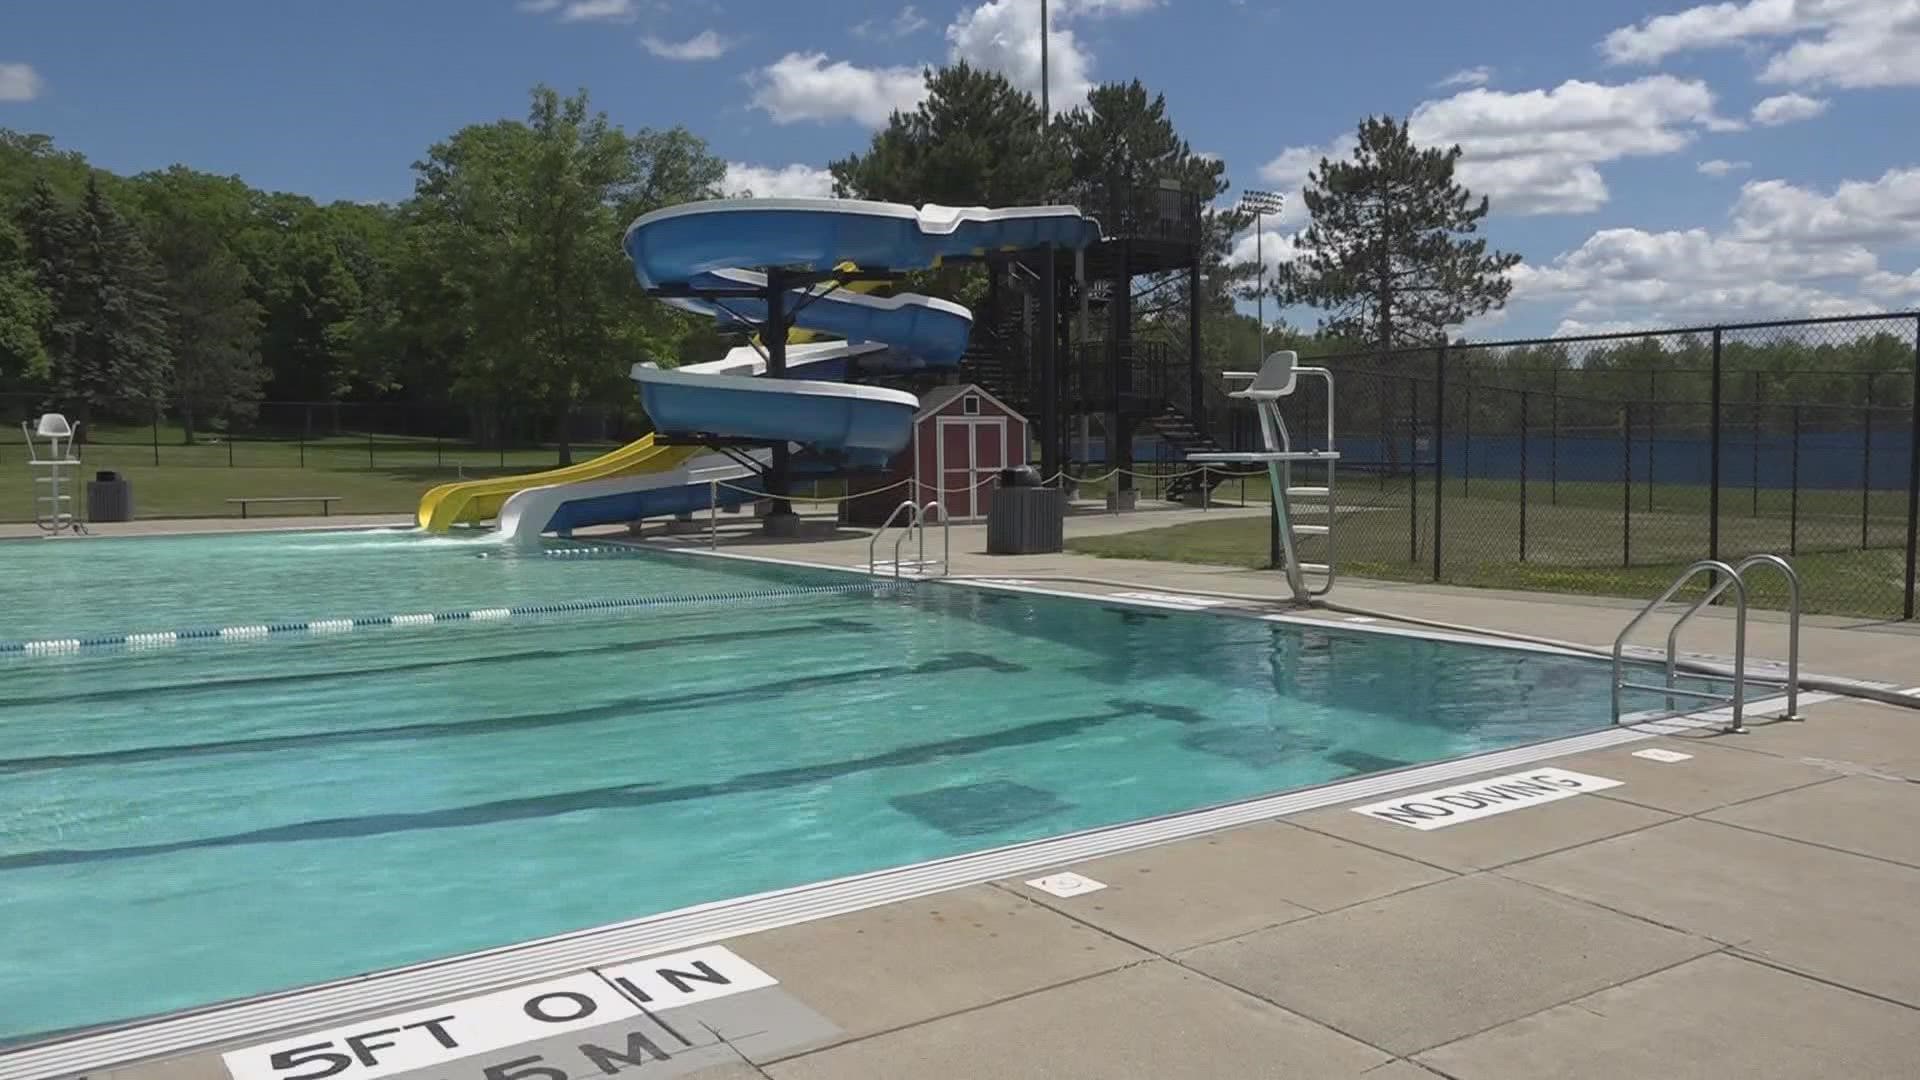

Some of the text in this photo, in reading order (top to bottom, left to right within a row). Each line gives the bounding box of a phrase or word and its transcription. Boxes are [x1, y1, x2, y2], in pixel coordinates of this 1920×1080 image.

[1371, 775, 1583, 825] NO DIVING
[614, 961, 732, 1003] IN
